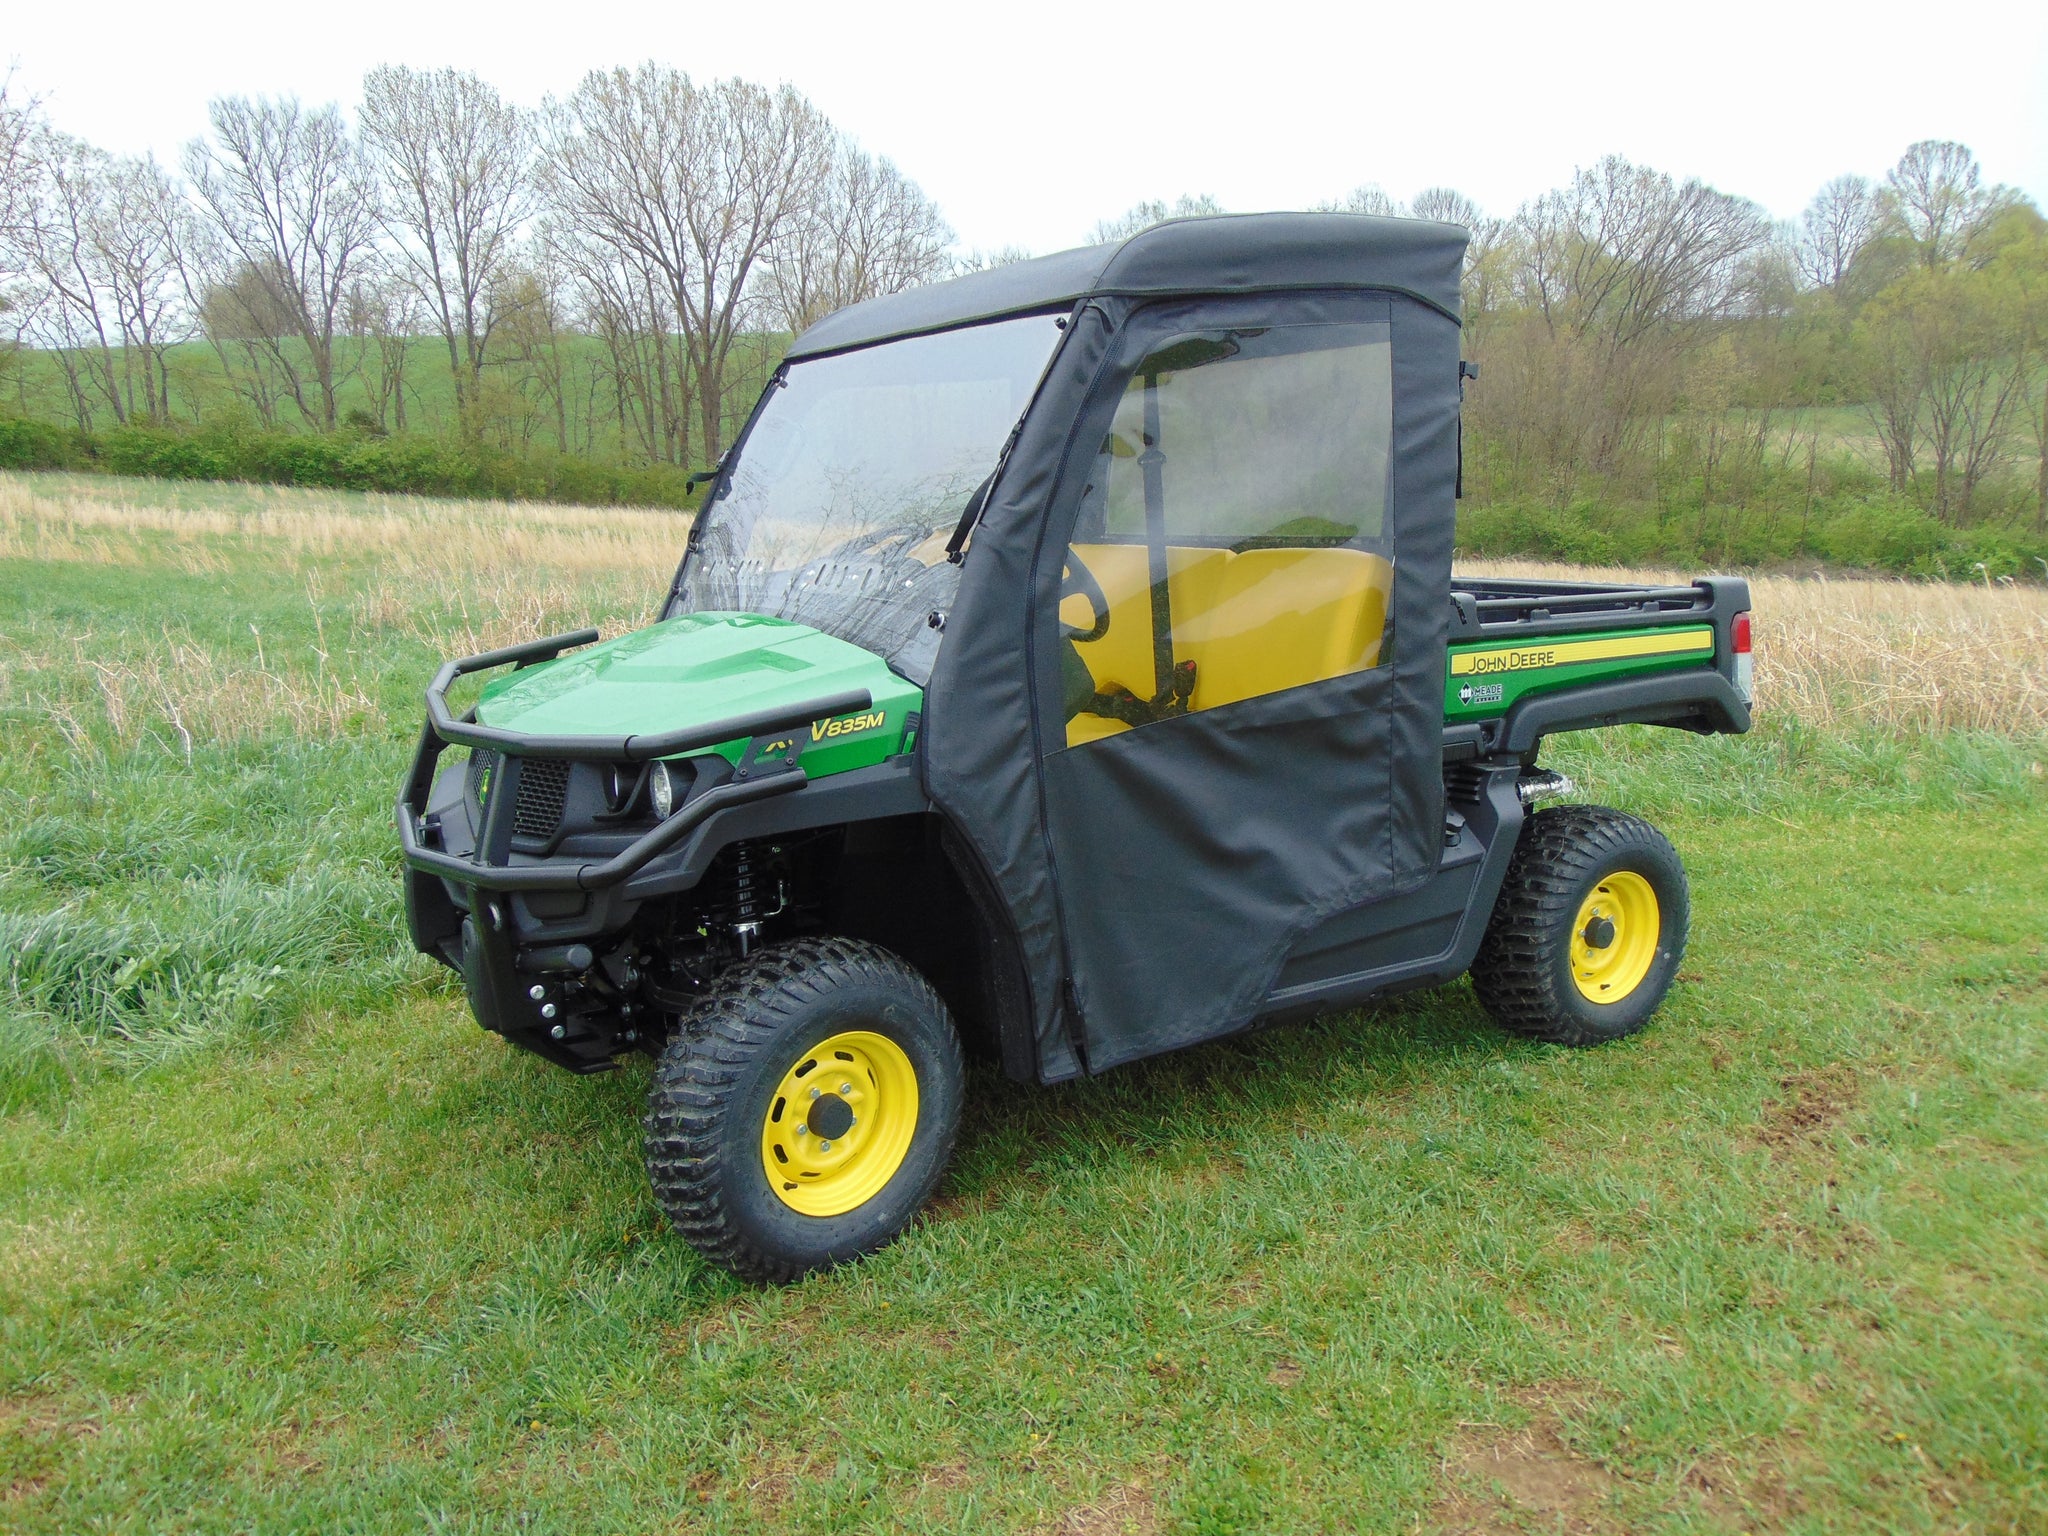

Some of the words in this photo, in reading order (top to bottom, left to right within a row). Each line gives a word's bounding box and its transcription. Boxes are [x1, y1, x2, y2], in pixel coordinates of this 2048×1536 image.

[1468, 656, 1507, 672] JOHN
[1510, 651, 1555, 667] DEERE
[1474, 684, 1502, 696] MEADE
